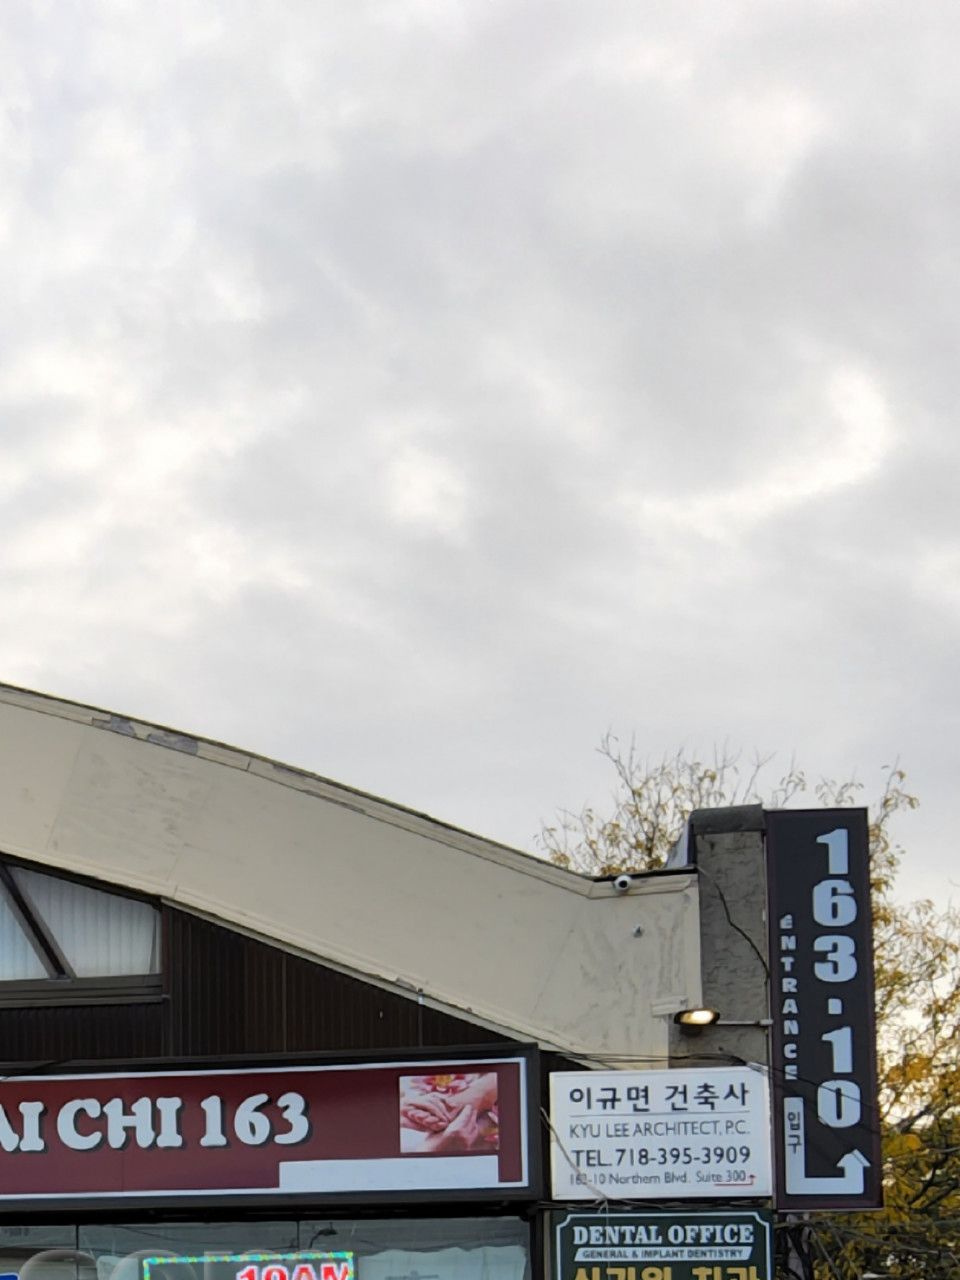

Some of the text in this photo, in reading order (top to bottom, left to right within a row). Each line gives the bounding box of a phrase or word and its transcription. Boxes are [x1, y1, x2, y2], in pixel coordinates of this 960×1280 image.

[780, 913, 800, 1081] ENTRANCE
[569, 1082, 749, 1113] 이규면 건축사
[56, 1096, 182, 1150] CHI
[200, 1092, 311, 1146] 163
[569, 1123, 601, 1138] KYU
[606, 1122, 631, 1137] LEE
[632, 1120, 723, 1137] ARCHITECT,
[787, 1110, 802, 1155] 입구
[609, 1173, 661, 1185] Northern
[696, 1171, 723, 1183] Suite
[726, 1170, 746, 1182] 300
[573, 1224, 755, 1245] DENTAL OFFICE
[582, 1250, 629, 1259] GENERAL
[641, 1249, 685, 1258] IMPLANT
[687, 1248, 743, 1258] DENTISTRY
